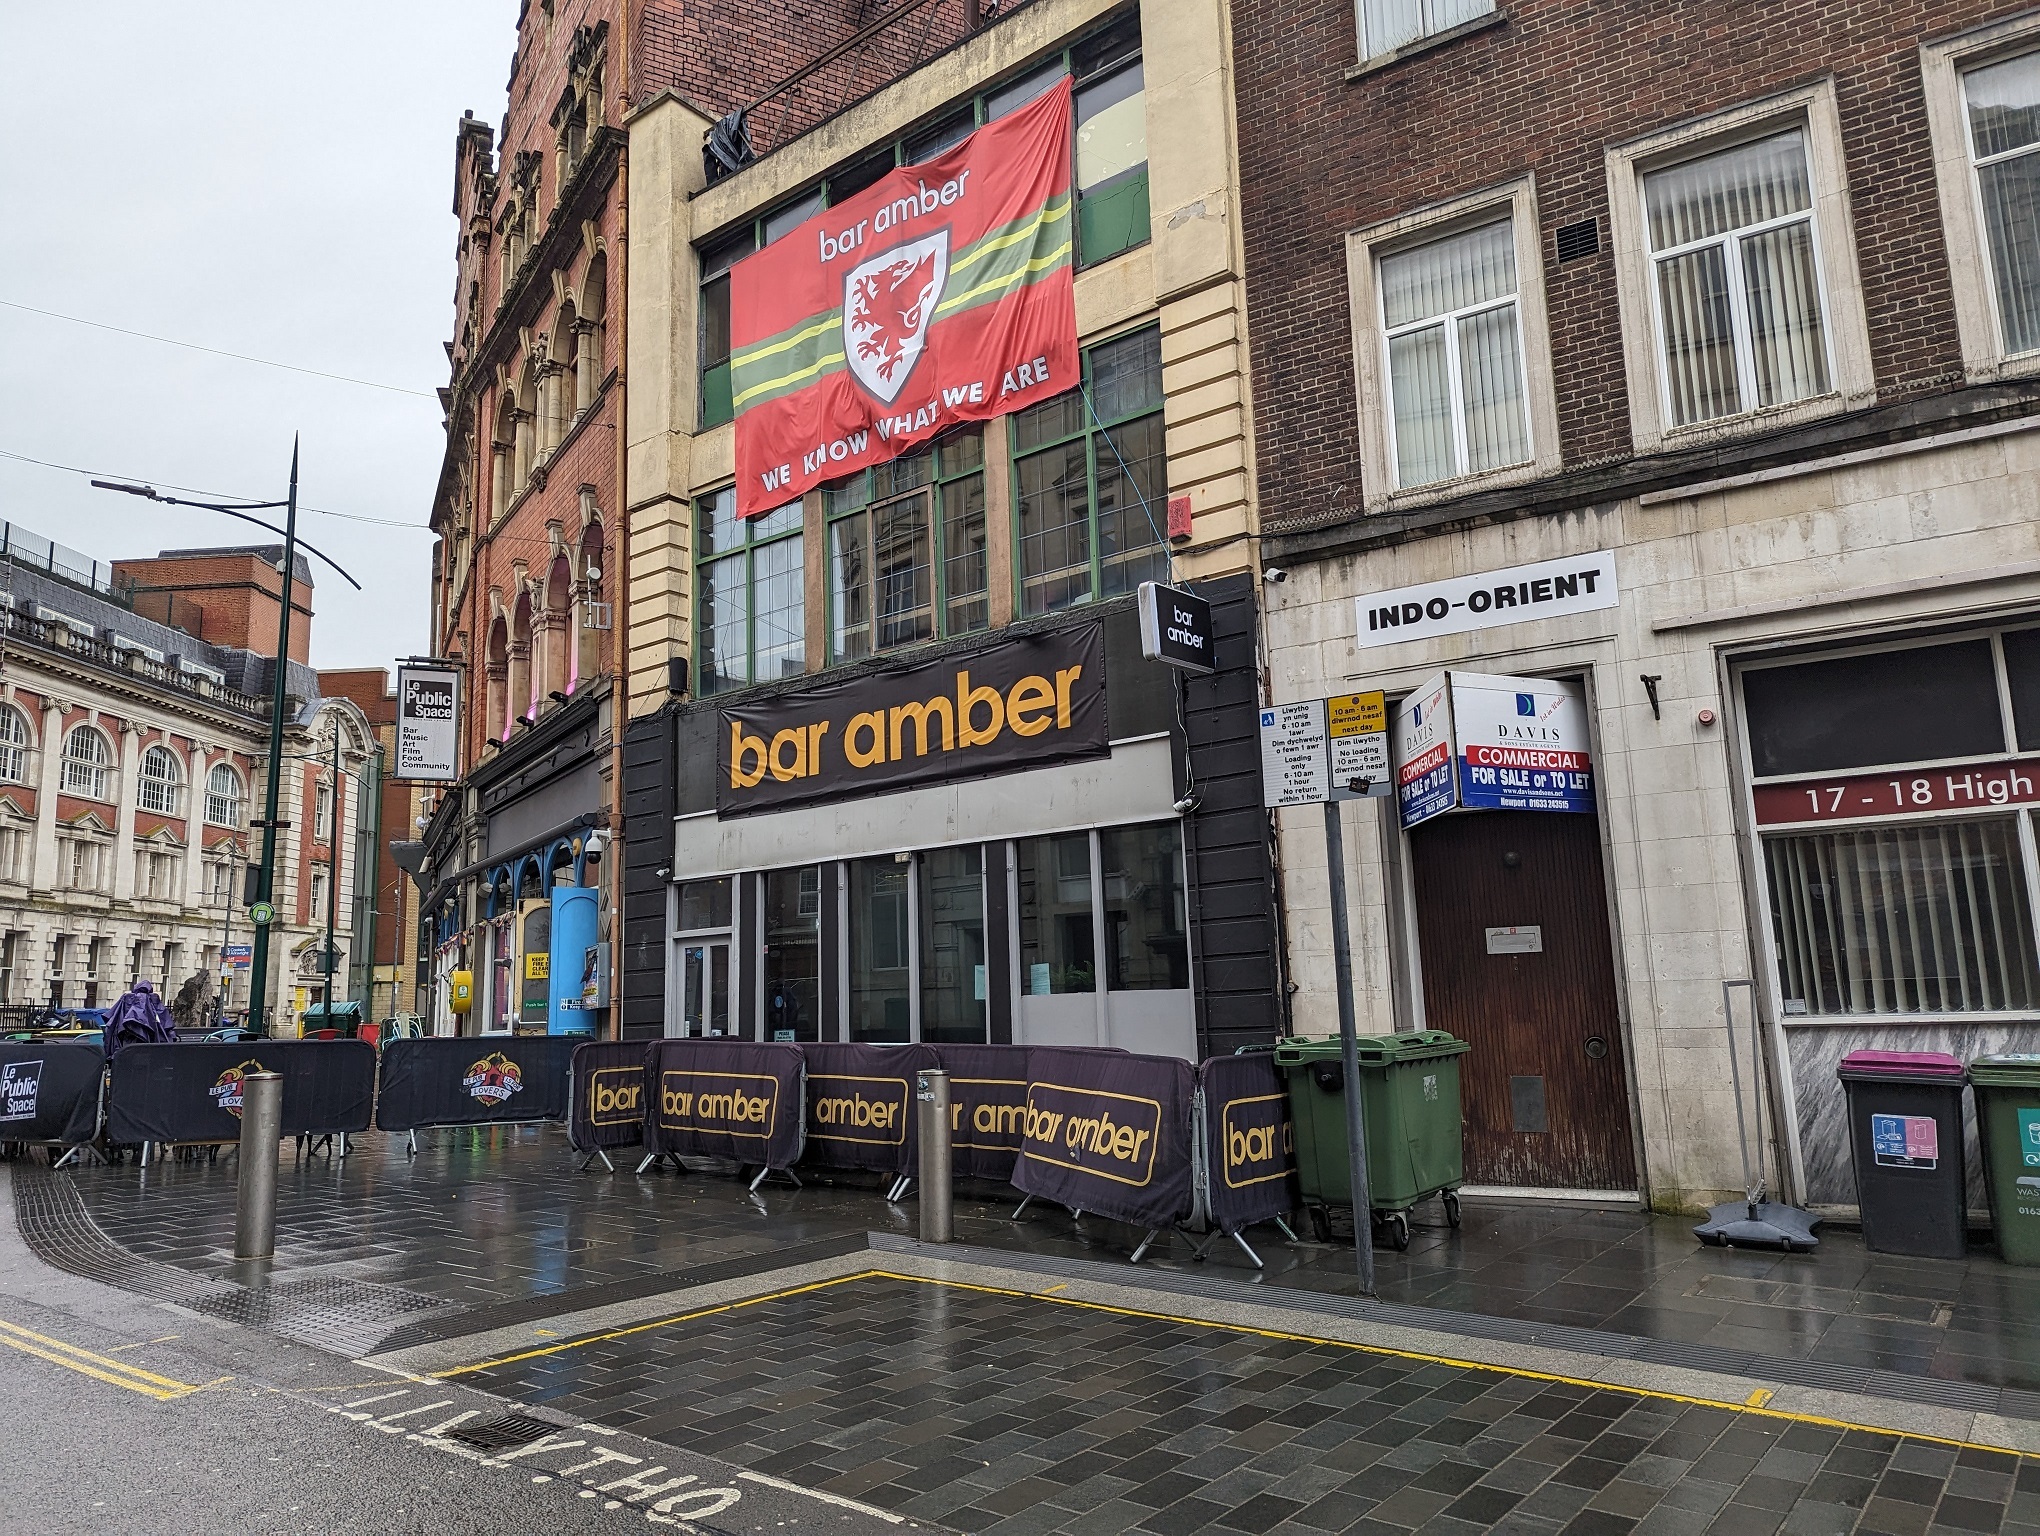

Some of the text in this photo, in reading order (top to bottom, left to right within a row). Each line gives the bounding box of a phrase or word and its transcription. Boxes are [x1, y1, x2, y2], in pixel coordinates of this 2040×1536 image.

[819, 169, 970, 263] bar amber
[760, 355, 1049, 493] WE KNOW WHAT WE ARE
[1368, 569, 1601, 631] INDO-ORIENT
[1174, 605, 1192, 627] bar
[1167, 625, 1204, 650] amber
[406, 680, 420, 690] Le
[406, 690, 452, 706] Public
[415, 704, 452, 718] Space
[1282, 705, 1309, 714] Llwytho
[1363, 711, 1382, 720] nesaf
[731, 664, 1083, 790] bar amber
[1407, 723, 1433, 750] DAVIS
[1498, 725, 1560, 740] DAVIS
[1287, 734, 1323, 745] dychwelyd
[1353, 736, 1380, 744] llwytho
[1285, 755, 1311, 763] Loading
[1352, 747, 1379, 755] loading
[1478, 748, 1580, 769] COMMERCIAL
[402, 762, 450, 770] Community
[1335, 762, 1385, 773] diwrnod nesaf
[1403, 748, 1443, 781] COMMERCIAL
[1401, 765, 1448, 803] FOR SALE or TO LET
[1471, 767, 1589, 790] FOR SALE or TO LET
[1503, 788, 1564, 796] www.davisandsons.net
[1805, 786, 1846, 814] 17
[1889, 778, 1933, 806] 18
[1945, 768, 2033, 804] High
[1501, 797, 1526, 807] Newport
[1529, 798, 1547, 808] 01633
[1406, 810, 1422, 823] Newport
[4, 1065, 16, 1079] Le
[1, 1077, 36, 1098] Public
[474, 1087, 505, 1097] LOVERS
[7, 1098, 34, 1115] Space
[596, 1083, 641, 1112] bar
[663, 1085, 770, 1123] bar amber
[816, 1093, 898, 1128] amber
[1026, 1099, 1064, 1143] bar
[1229, 1121, 1275, 1167] bar
